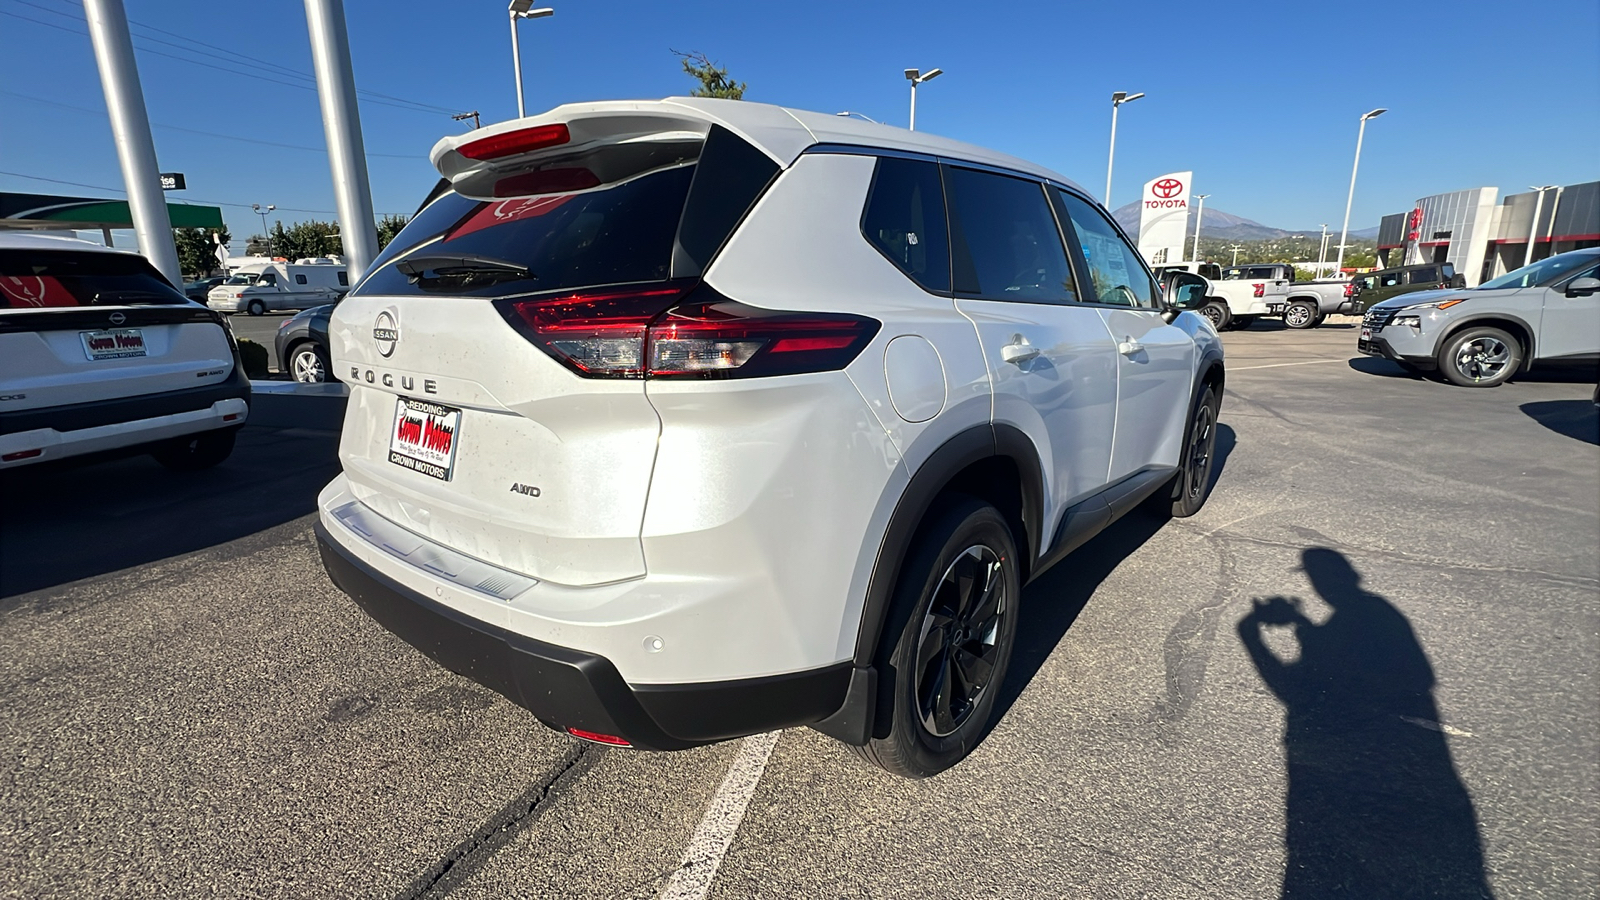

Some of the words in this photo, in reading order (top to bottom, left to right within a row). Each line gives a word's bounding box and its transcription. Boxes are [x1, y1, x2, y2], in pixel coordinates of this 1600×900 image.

[1145, 200, 1187, 208] TOYOTA
[351, 366, 437, 394] ROGUE
[409, 401, 443, 415] REDDING
[391, 453, 415, 469] CROWN
[415, 460, 445, 478] MOTORS
[510, 482, 541, 498] AWD
